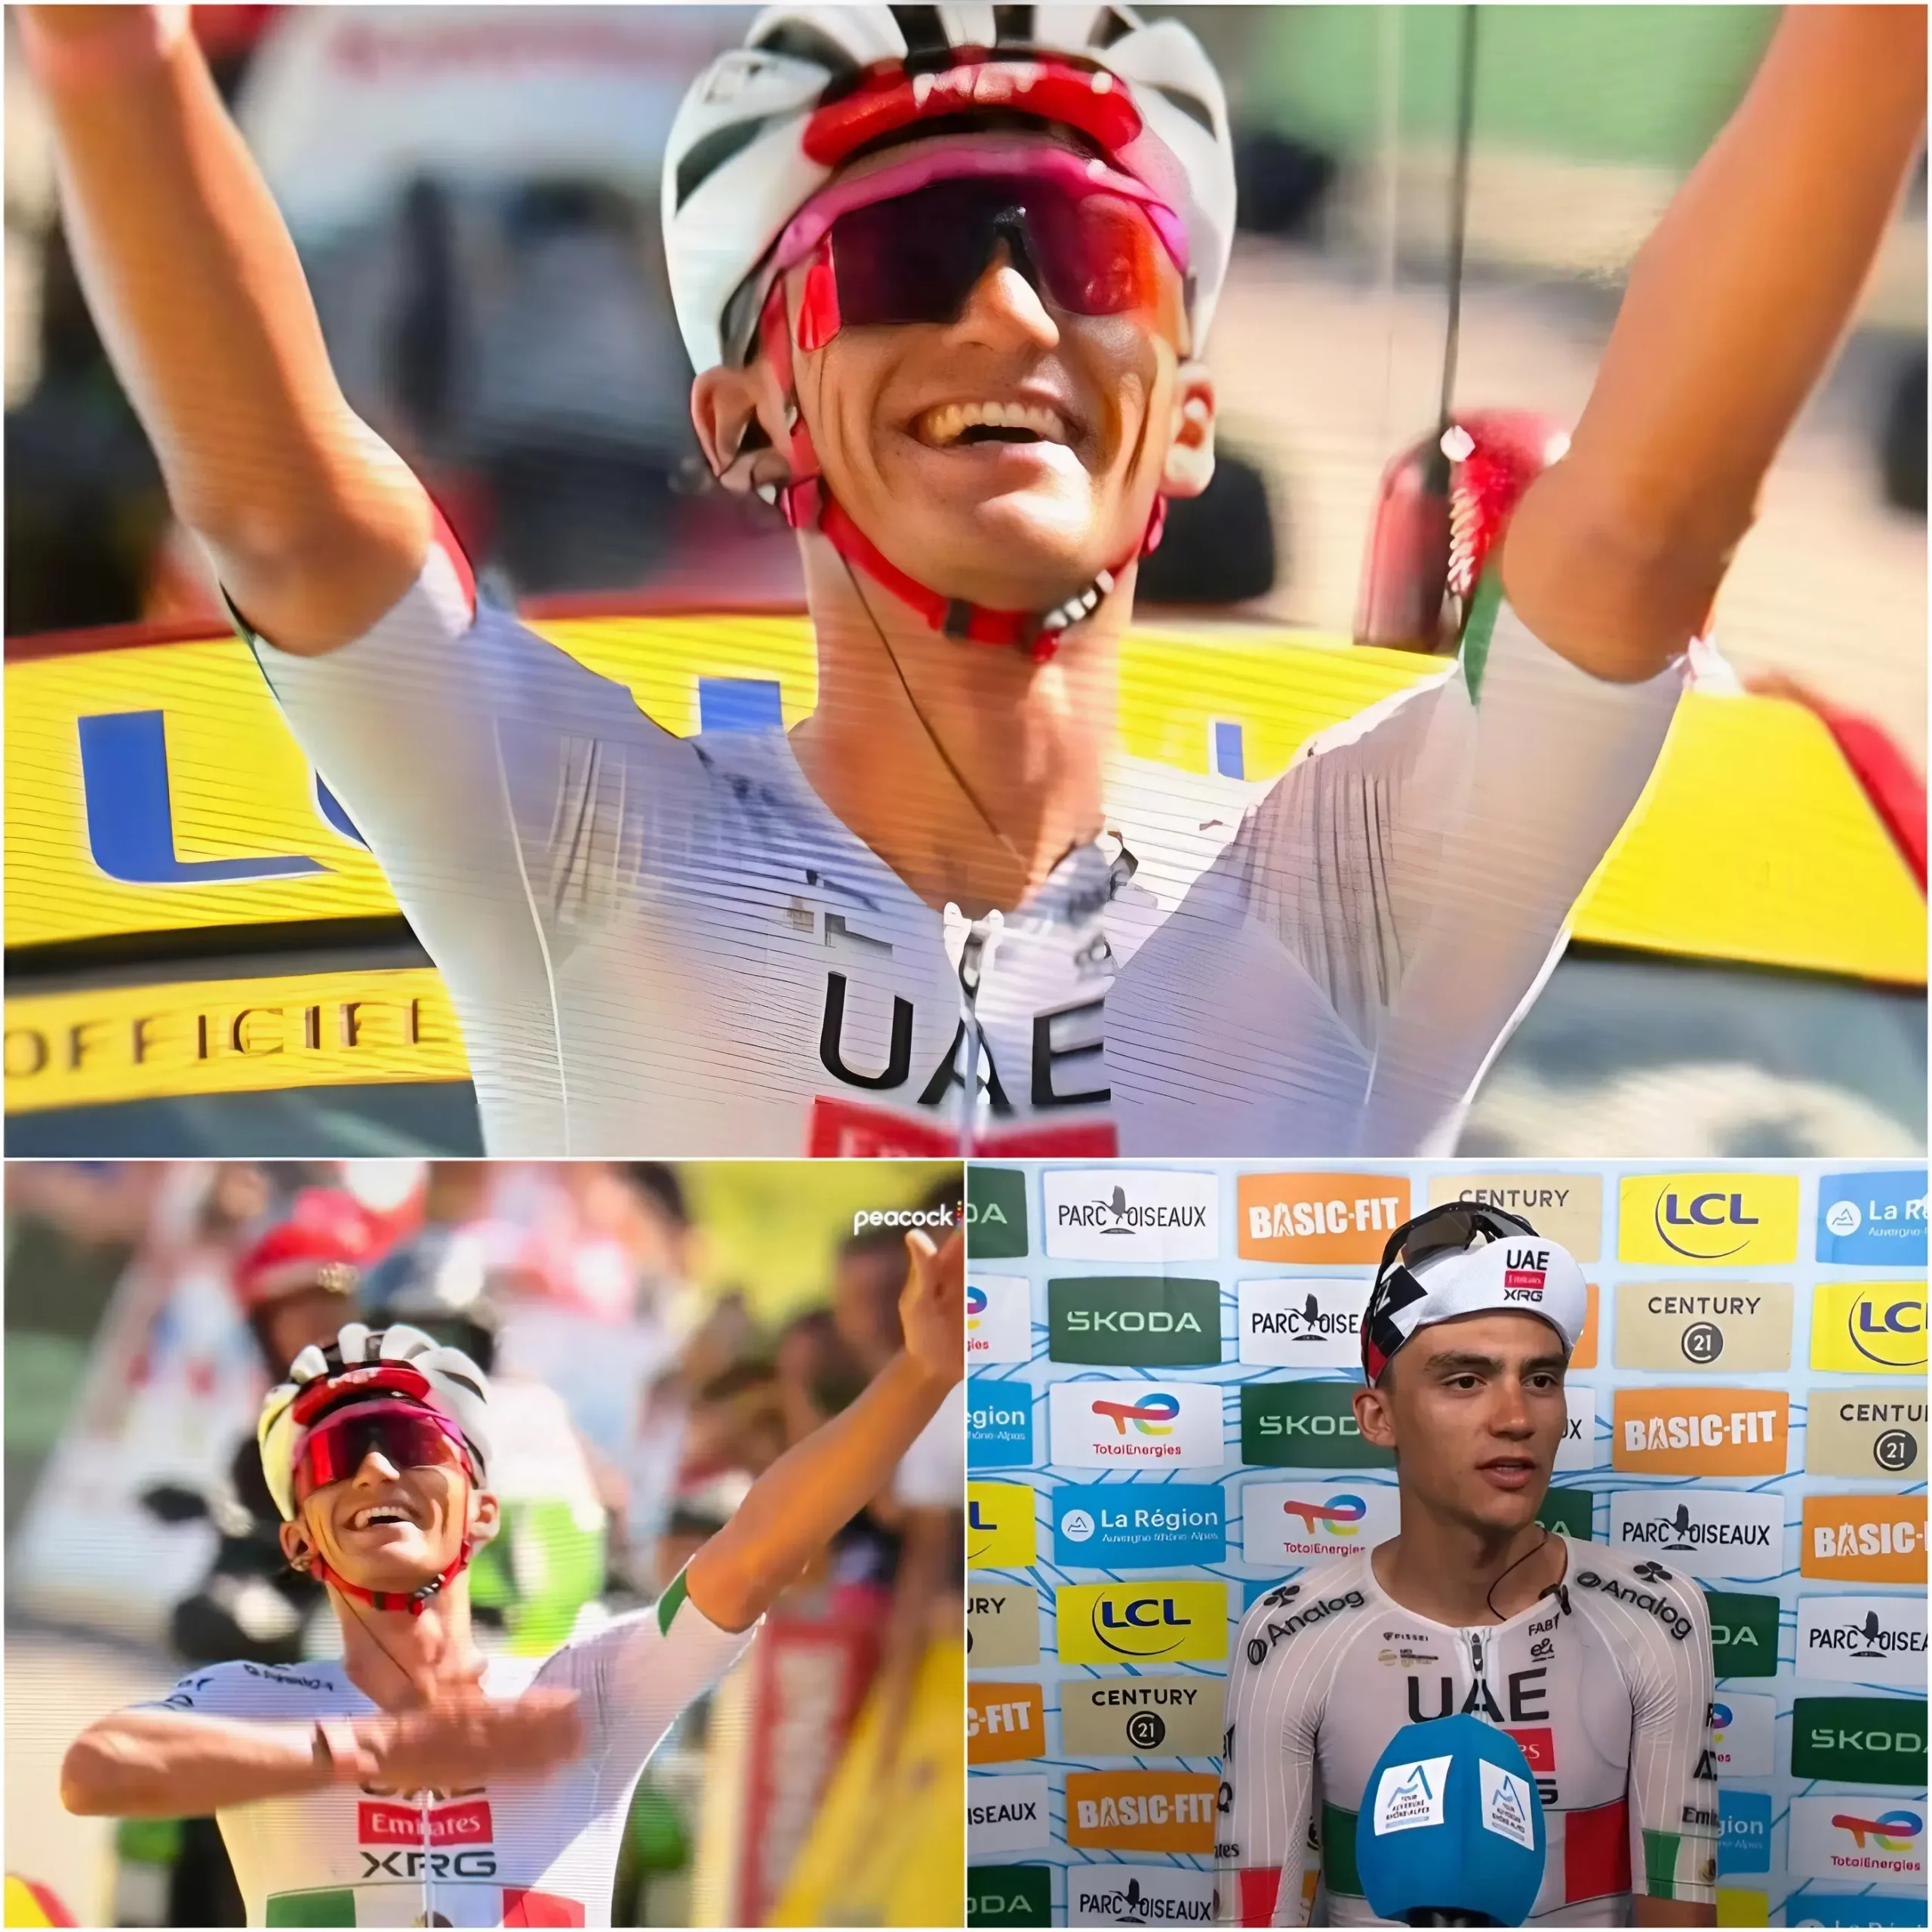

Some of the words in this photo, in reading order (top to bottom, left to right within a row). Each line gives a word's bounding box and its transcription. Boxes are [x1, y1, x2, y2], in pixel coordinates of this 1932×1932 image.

[820, 971, 1111, 1105] UAE
[1460, 1189, 1570, 1208] CENTURY
[1665, 1192, 1759, 1226] LCL
[1869, 1200, 1897, 1220] La
[1058, 1204, 1106, 1227] PARC
[1128, 1205, 1206, 1227] OISEAUX
[1249, 1197, 1399, 1238] BASIC-FIT
[1506, 1249, 1549, 1271] UAE
[1503, 1289, 1543, 1303] XRG
[1648, 1296, 1761, 1315] CENTURY
[1251, 1312, 1300, 1334] PARC
[1860, 1301, 1928, 1334] LC
[1694, 1334, 1711, 1352] 21
[1839, 1404, 1928, 1423] CENTU
[1625, 1411, 1777, 1451] BASIC-FIT
[1886, 1442, 1904, 1459] 21
[1101, 1509, 1128, 1528] La
[1135, 1508, 1218, 1531] Région
[1623, 1521, 1669, 1543] PARC
[1690, 1522, 1770, 1546] OISEAUX
[1102, 1598, 1192, 1628] LCL
[1269, 1589, 1365, 1647] Analog
[1600, 1579, 1693, 1641] Analog
[1809, 1628, 1858, 1651] PARC
[1091, 1688, 1198, 1707] CENTURY
[1407, 1666, 1550, 1724] UAE
[1138, 1721, 1155, 1738] 21
[1078, 1792, 1214, 1829] BASIC-FIT
[371, 1813, 481, 1837] Emirates
[361, 1850, 496, 1878] XRG
[1080, 1894, 1122, 1916] PARC
[1139, 1897, 1211, 1921] OISEAUX
